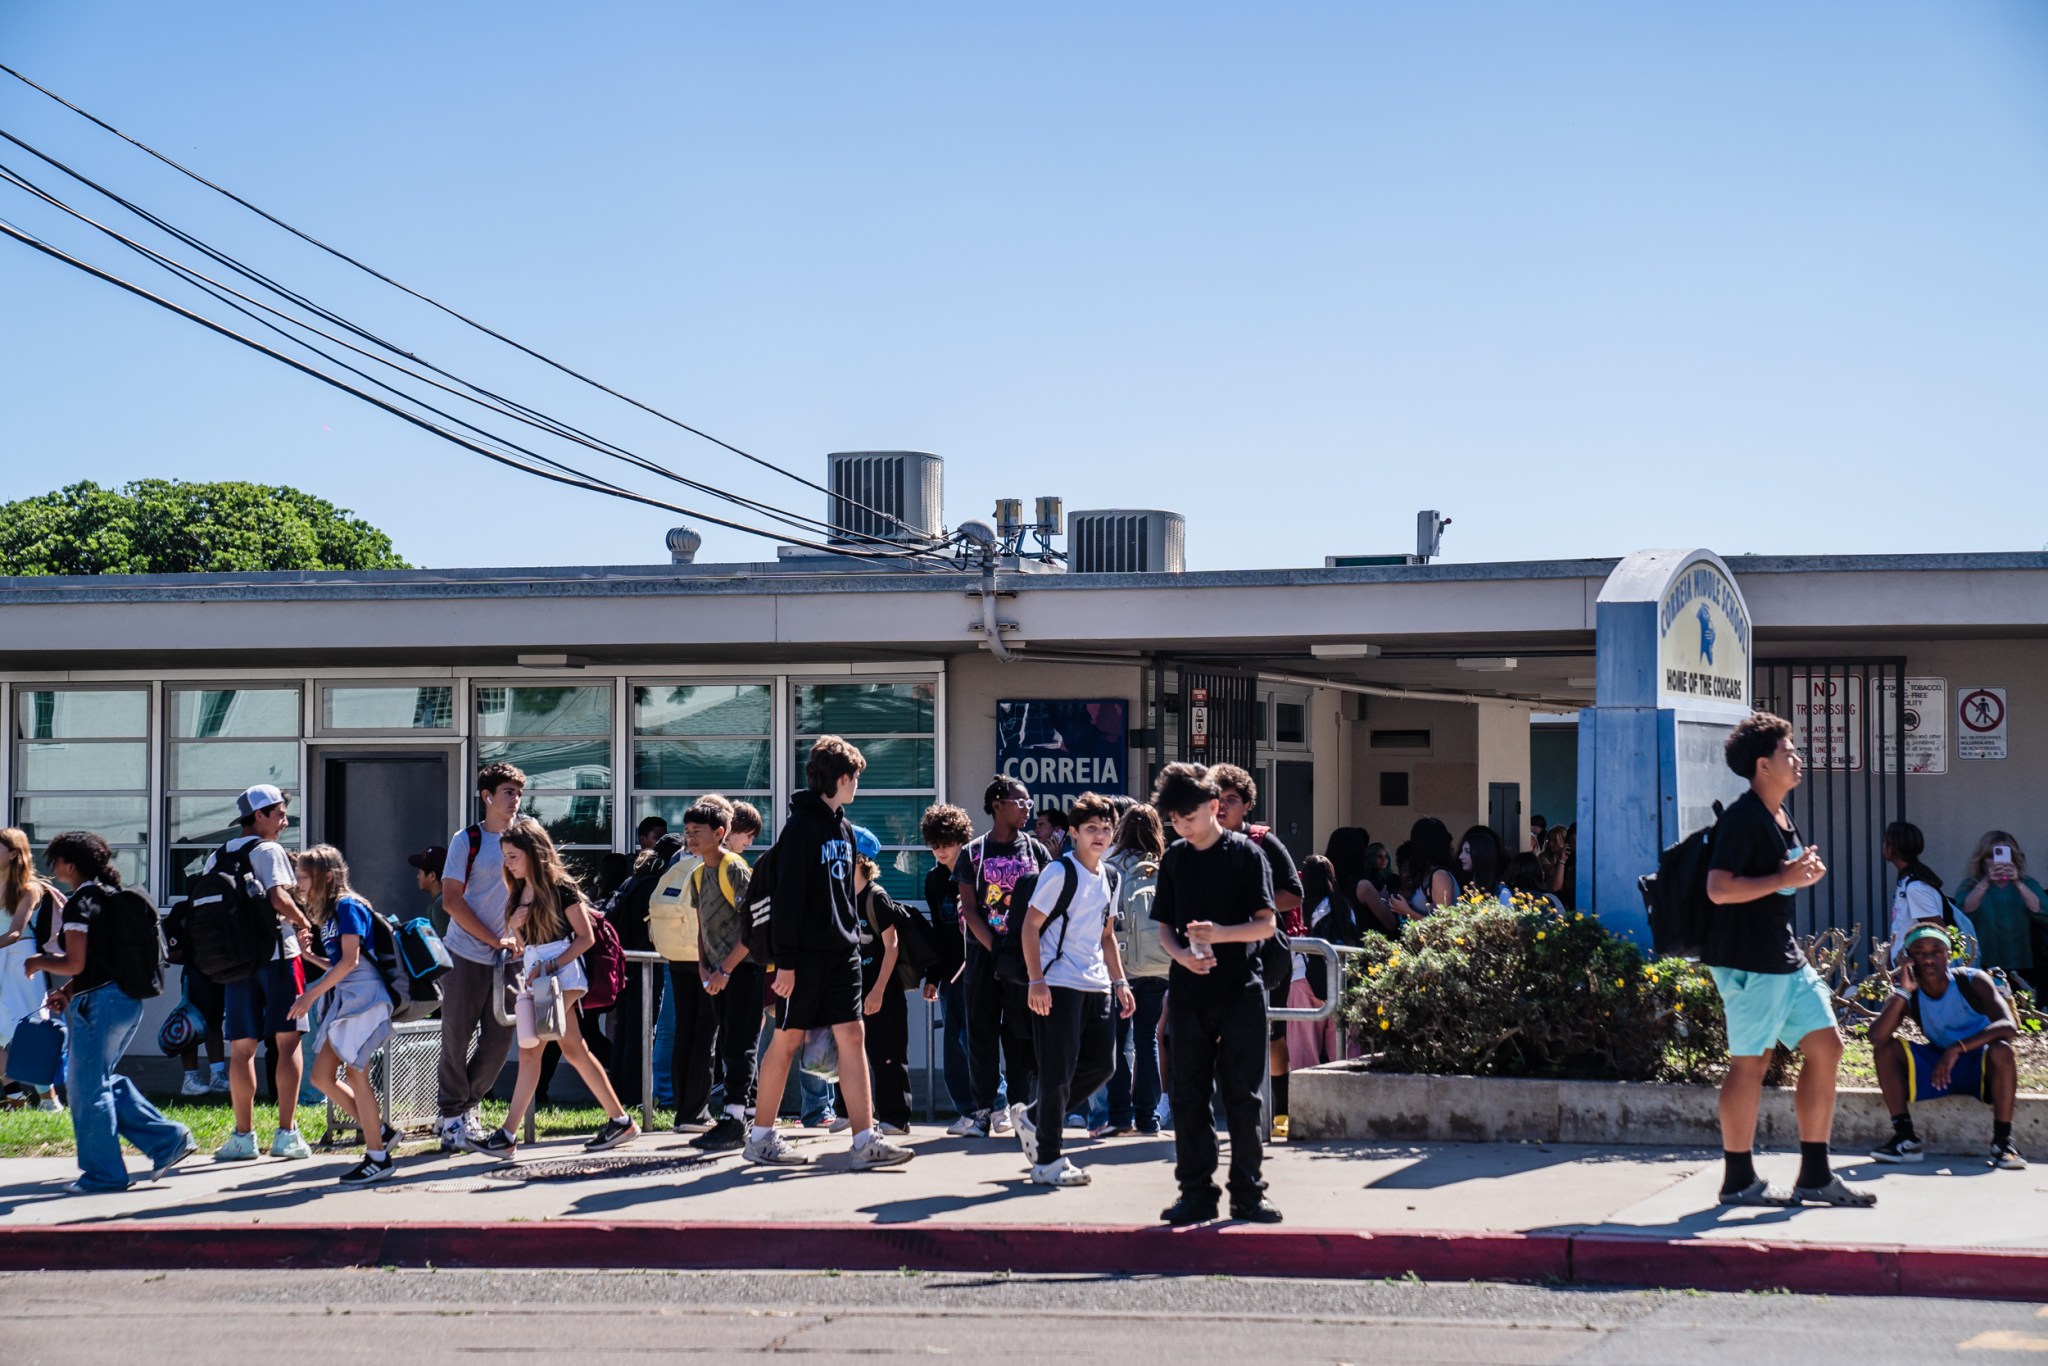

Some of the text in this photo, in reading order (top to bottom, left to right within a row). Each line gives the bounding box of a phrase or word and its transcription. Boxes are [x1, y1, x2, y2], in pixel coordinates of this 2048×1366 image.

[1661, 569, 1746, 655] CORREIA MIDDLE SCHOOL
[1666, 668, 1742, 700] HOME OF THE COUGARS
[1003, 757, 1119, 784] CORREIA
